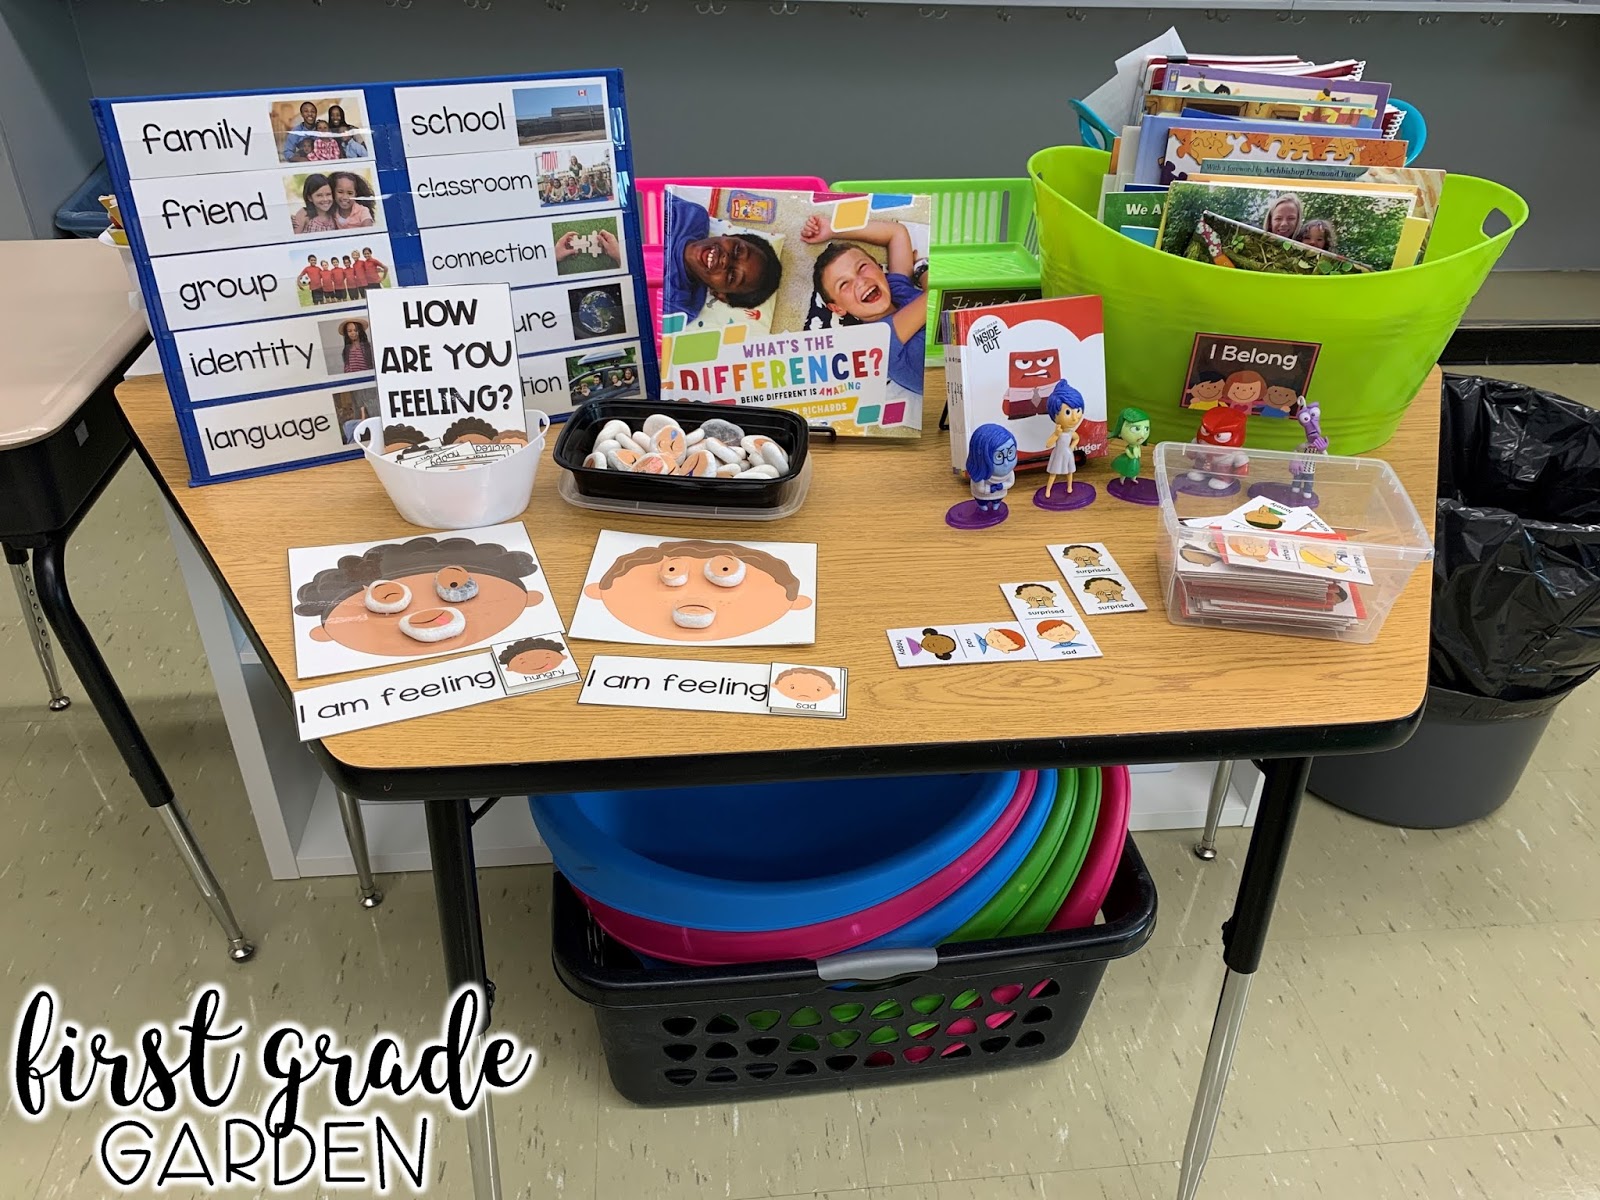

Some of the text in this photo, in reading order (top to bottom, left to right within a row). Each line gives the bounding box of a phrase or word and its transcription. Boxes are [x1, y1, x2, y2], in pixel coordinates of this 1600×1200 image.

[411, 102, 506, 135] school
[142, 118, 252, 156] family
[1264, 165, 1304, 177] Archbishop
[1306, 169, 1339, 178] Desmond
[417, 174, 533, 199] classroom
[161, 191, 268, 229] friend
[1126, 203, 1148, 215] We
[432, 242, 547, 271] connection
[179, 273, 278, 311] group
[402, 298, 478, 329] HOW
[743, 335, 834, 358] WHAT'S THE
[973, 325, 1001, 347] INSIDE
[982, 336, 1001, 354] OUT
[188, 338, 314, 377] identity
[381, 340, 512, 374] ARE YOU
[1210, 344, 1298, 371] I Belong
[680, 347, 883, 395] DIFFERENCE?
[388, 384, 514, 419] FEELING?
[740, 382, 861, 405] BEING DIFFERENT IS AMAZING
[802, 402, 847, 416] RICHARDS
[204, 414, 331, 452] language
[1075, 443, 1102, 455] nger
[1075, 566, 1111, 576] surprised
[1027, 607, 1065, 617] surprised
[1097, 601, 1135, 612] surprised
[895, 639, 906, 656] happy
[965, 638, 976, 648] sad
[523, 667, 566, 682] hungry
[587, 669, 769, 702] I am feeling
[299, 670, 497, 724] I am feeling
[795, 702, 817, 710] sad
